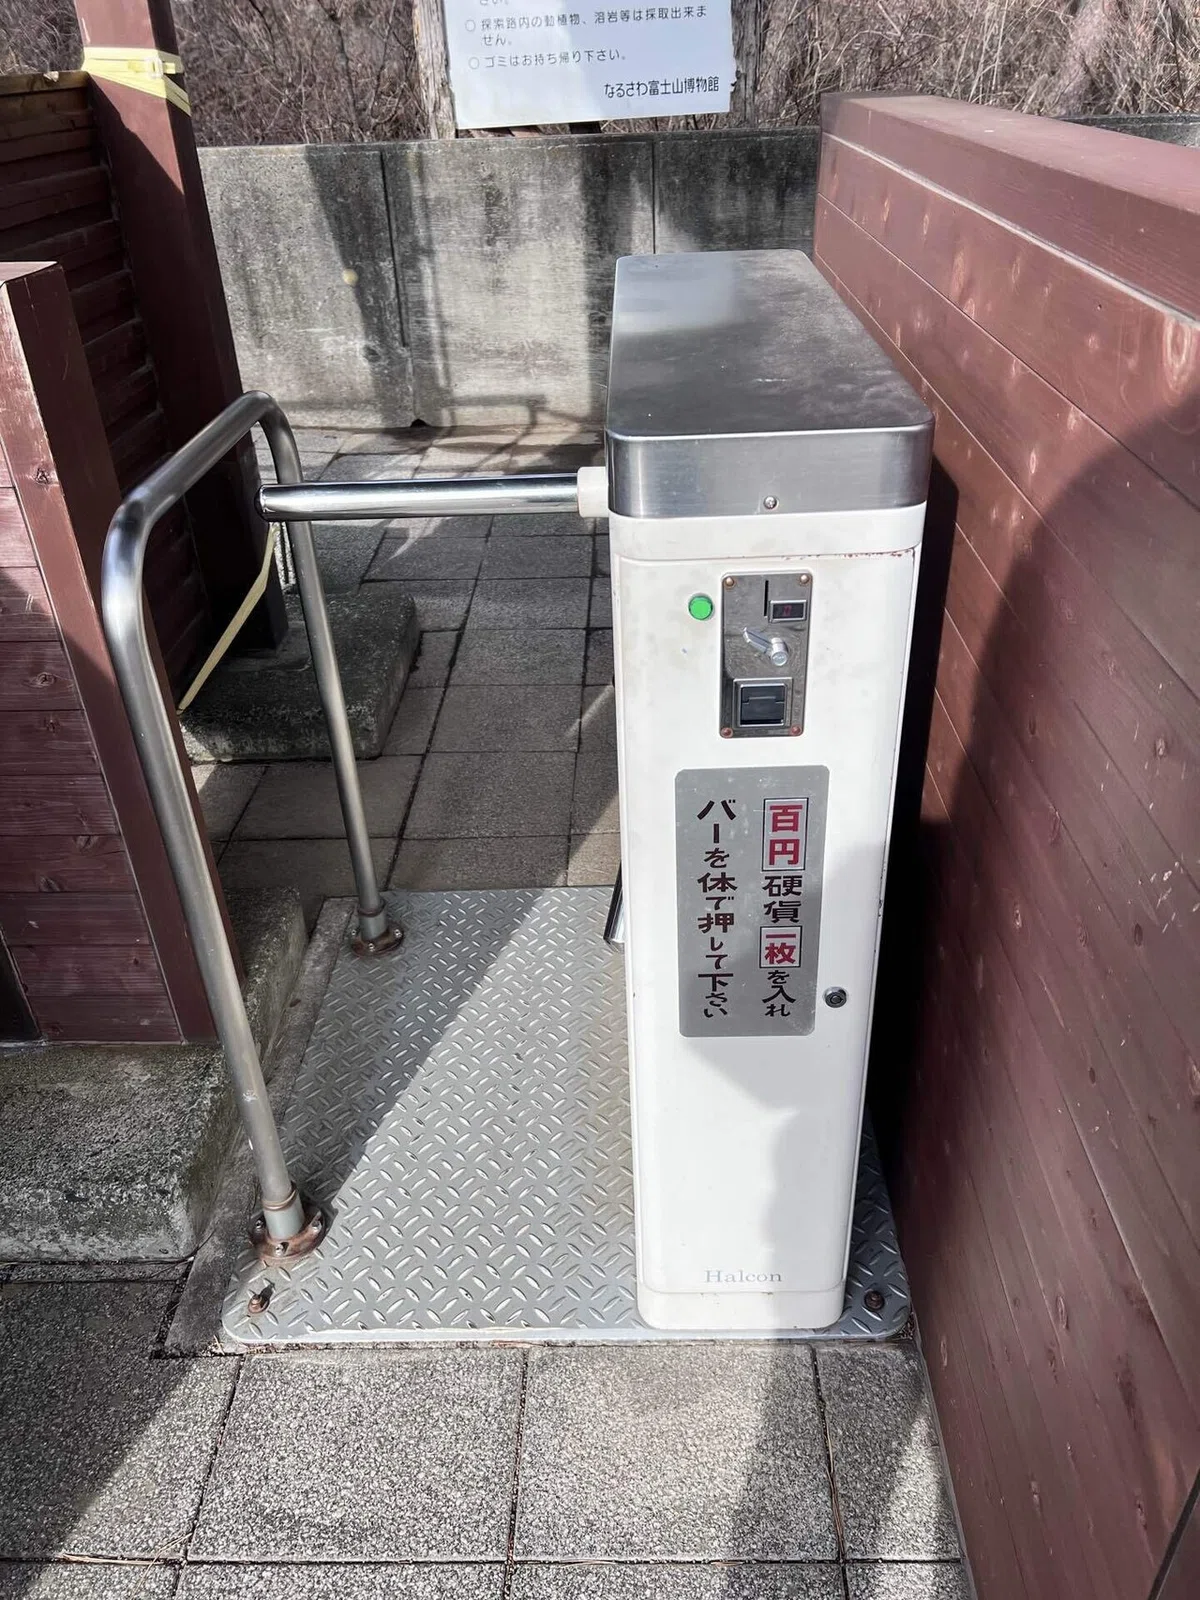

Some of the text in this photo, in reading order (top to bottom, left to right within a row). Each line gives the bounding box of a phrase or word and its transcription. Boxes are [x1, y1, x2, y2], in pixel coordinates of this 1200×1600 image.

[482, 34, 512, 46] せん。
[604, 76, 719, 98] なるさわ富士山博物館
[697, 799, 738, 1018] バーを体で押して下さい
[704, 1269, 782, 1283] Halcon
